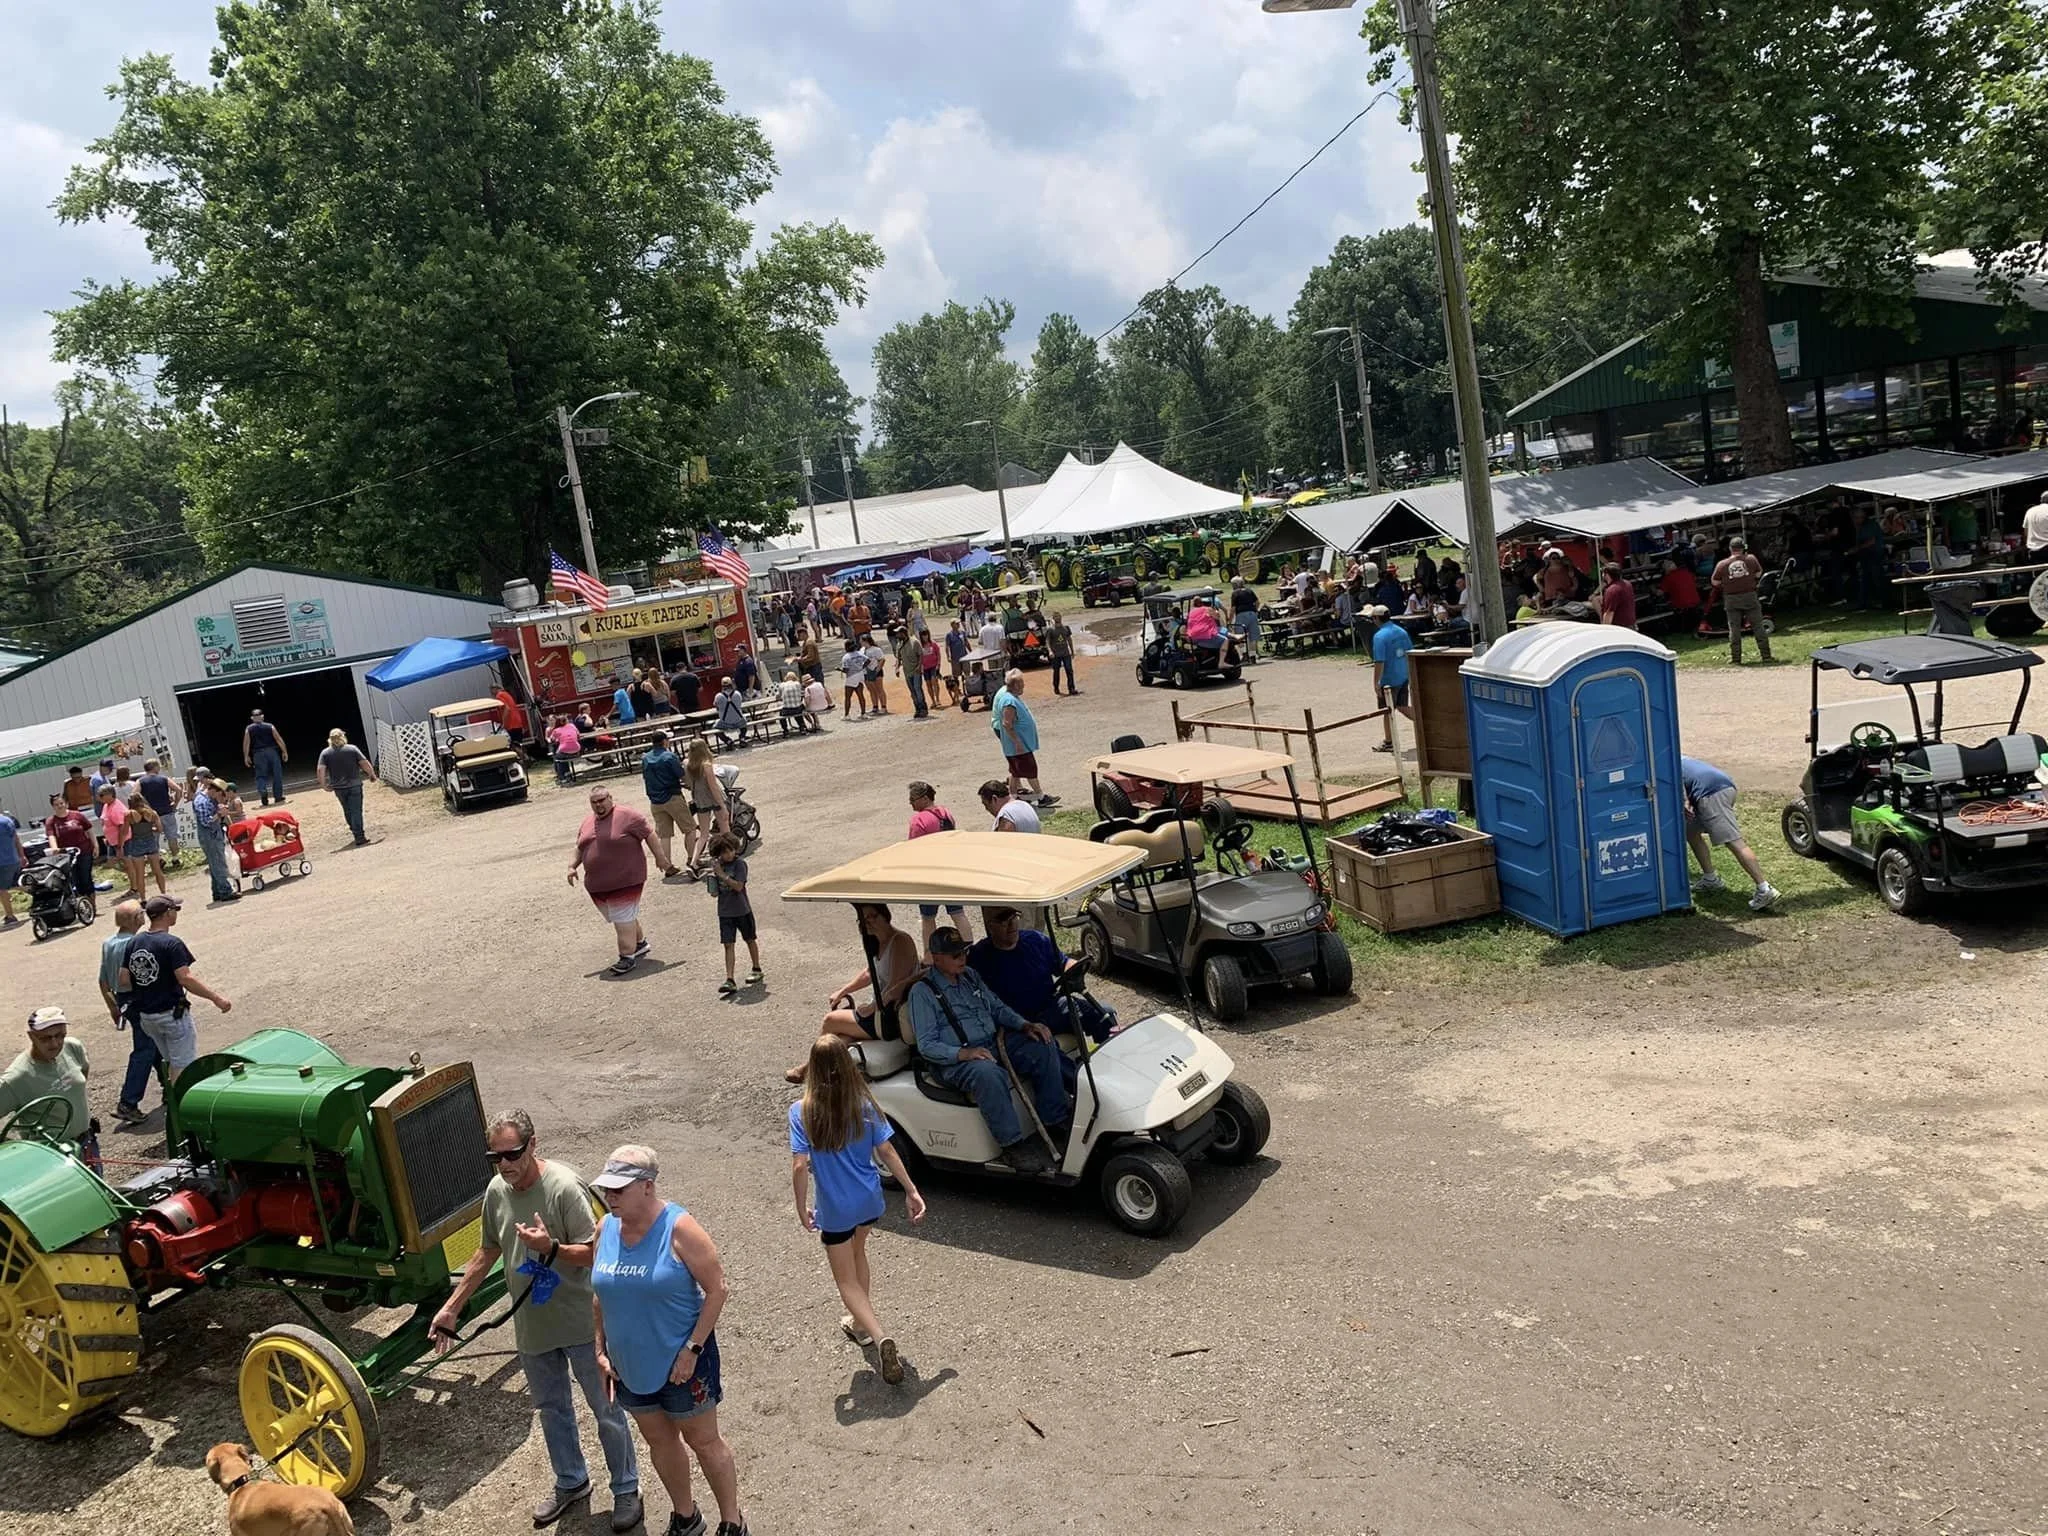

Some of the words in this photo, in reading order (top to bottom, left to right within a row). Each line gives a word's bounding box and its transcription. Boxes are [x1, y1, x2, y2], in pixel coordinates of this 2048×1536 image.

[542, 623, 562, 634] TACO
[594, 612, 639, 633] KURLY
[652, 602, 700, 624] TATERS
[247, 655, 281, 670] BUILDING
[396, 1073, 443, 1111] WATERLOO
